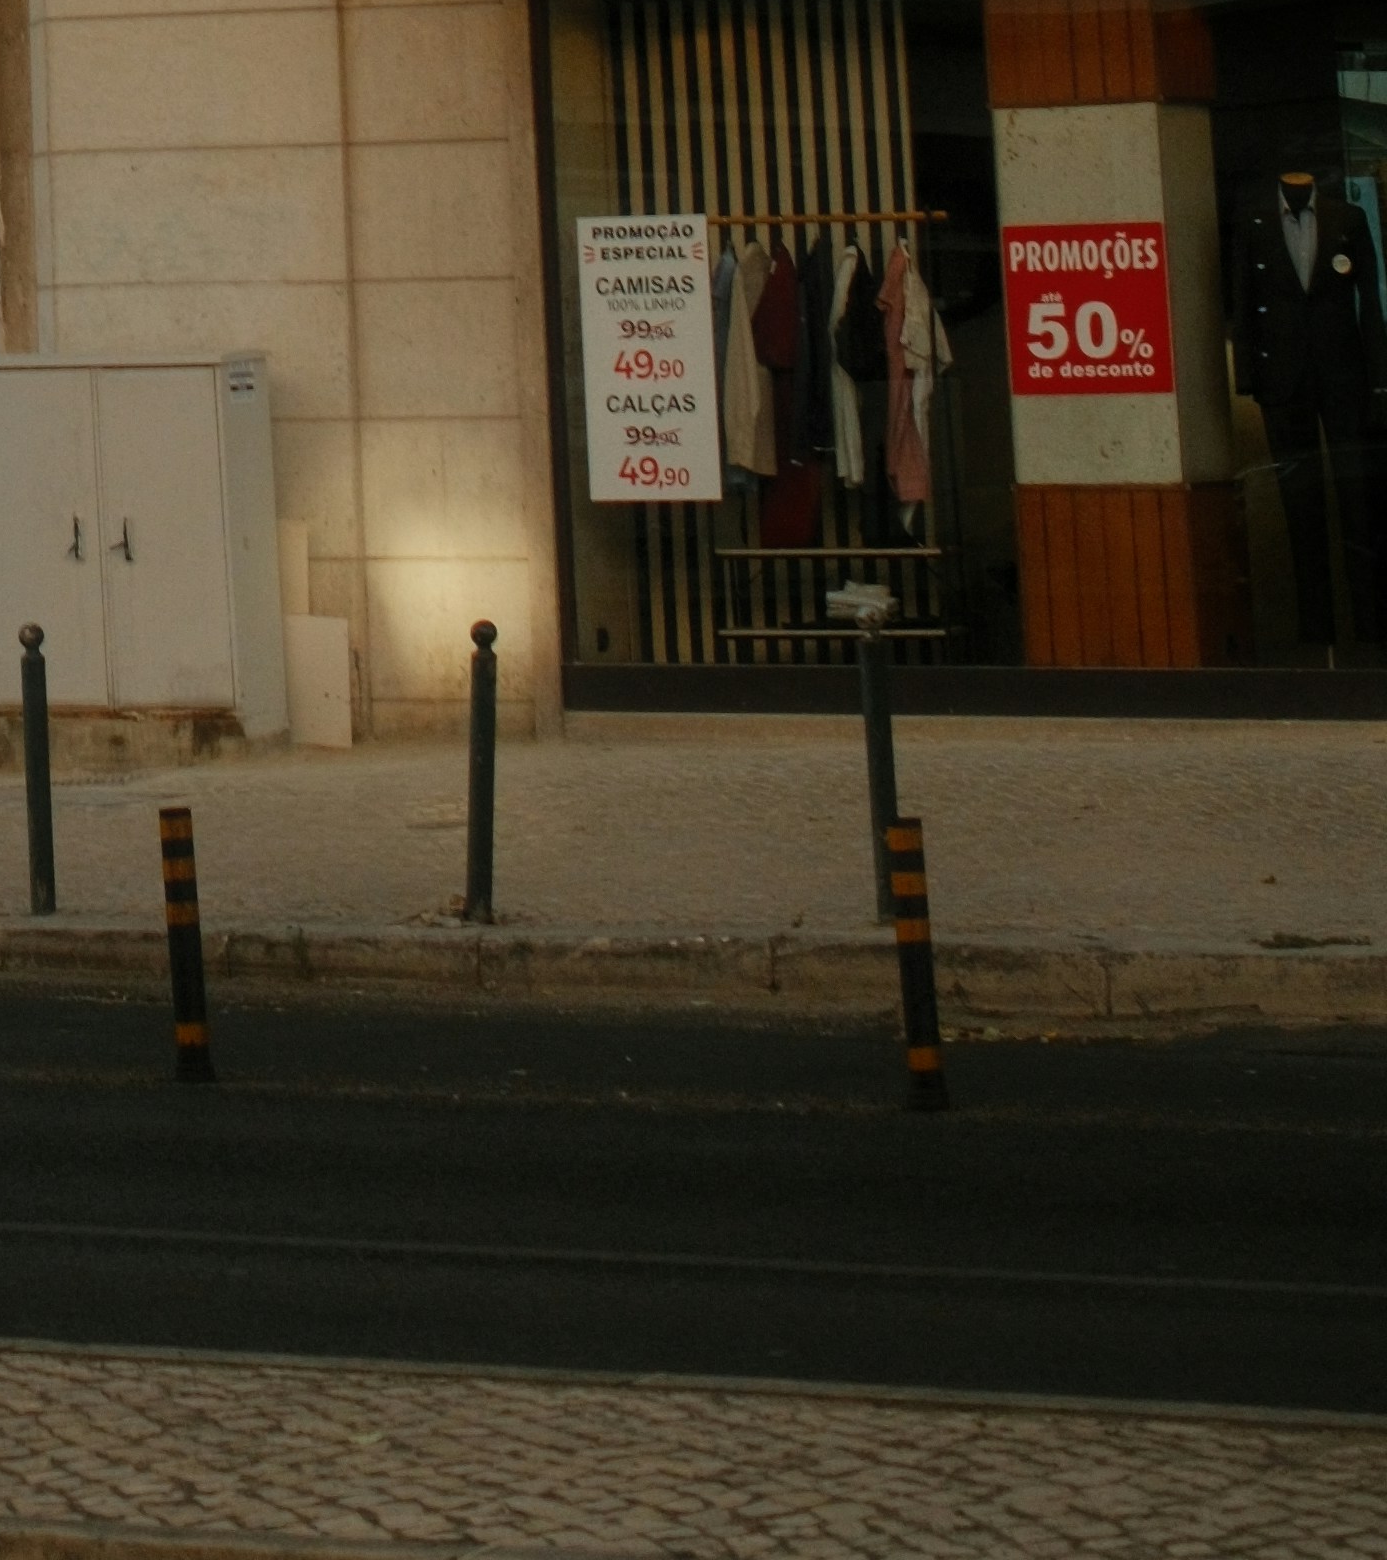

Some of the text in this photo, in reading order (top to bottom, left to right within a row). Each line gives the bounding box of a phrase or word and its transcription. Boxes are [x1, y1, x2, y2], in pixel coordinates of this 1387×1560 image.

[591, 222, 695, 241] PROMOÇÃO
[600, 243, 688, 261] ESPECIAL
[1008, 230, 1160, 280] PROMOÇÕES
[595, 274, 696, 296] CAMISAS
[606, 297, 686, 312] 100% LINHO
[1040, 291, 1063, 304] até
[1026, 300, 1155, 360] 50%
[613, 348, 685, 382] 49,90
[1027, 360, 1156, 379] de desconto
[605, 393, 697, 418] CALÇAS
[618, 455, 691, 490] 49,90
